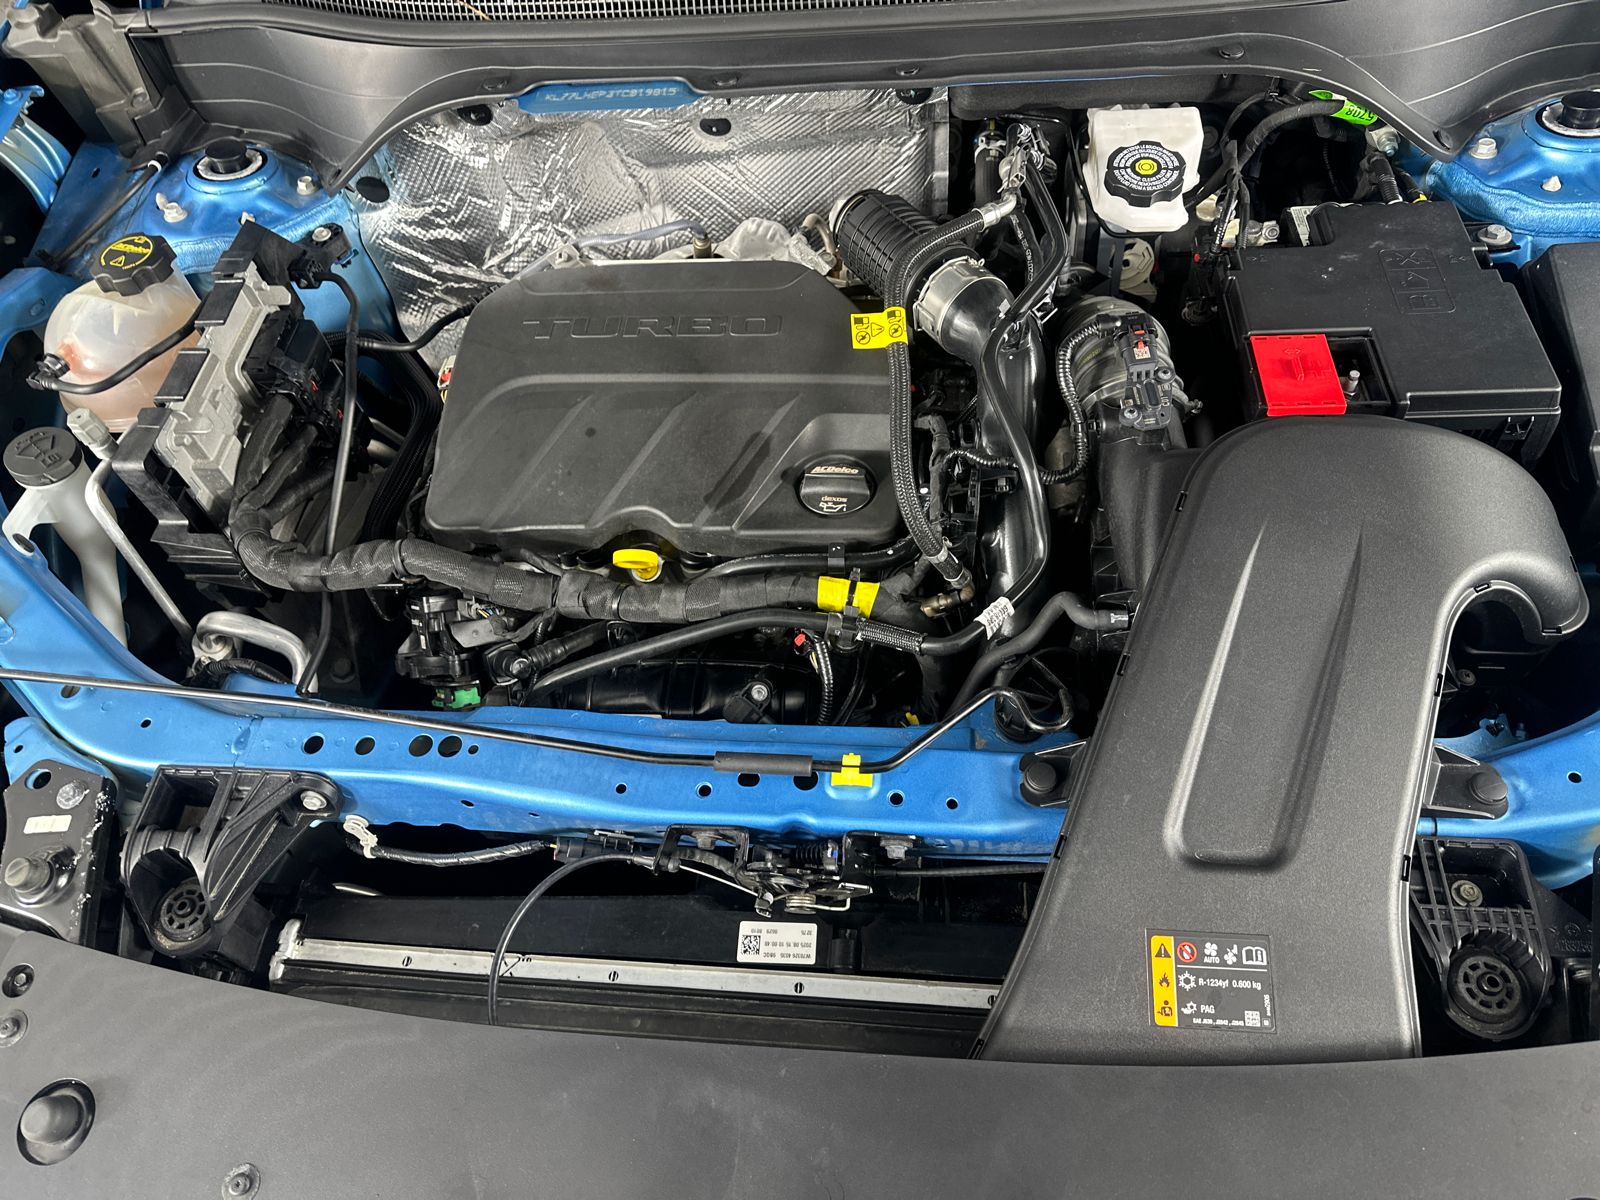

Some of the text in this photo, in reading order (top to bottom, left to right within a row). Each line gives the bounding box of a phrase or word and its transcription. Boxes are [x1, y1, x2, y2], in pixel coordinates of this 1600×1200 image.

[522, 314, 783, 340] TURBO
[810, 465, 859, 475] ACDelco
[821, 495, 848, 503] dexos
[1198, 979, 1262, 990] R-1234yf 0.600 kg
[1201, 1005, 1215, 1014] PAG
